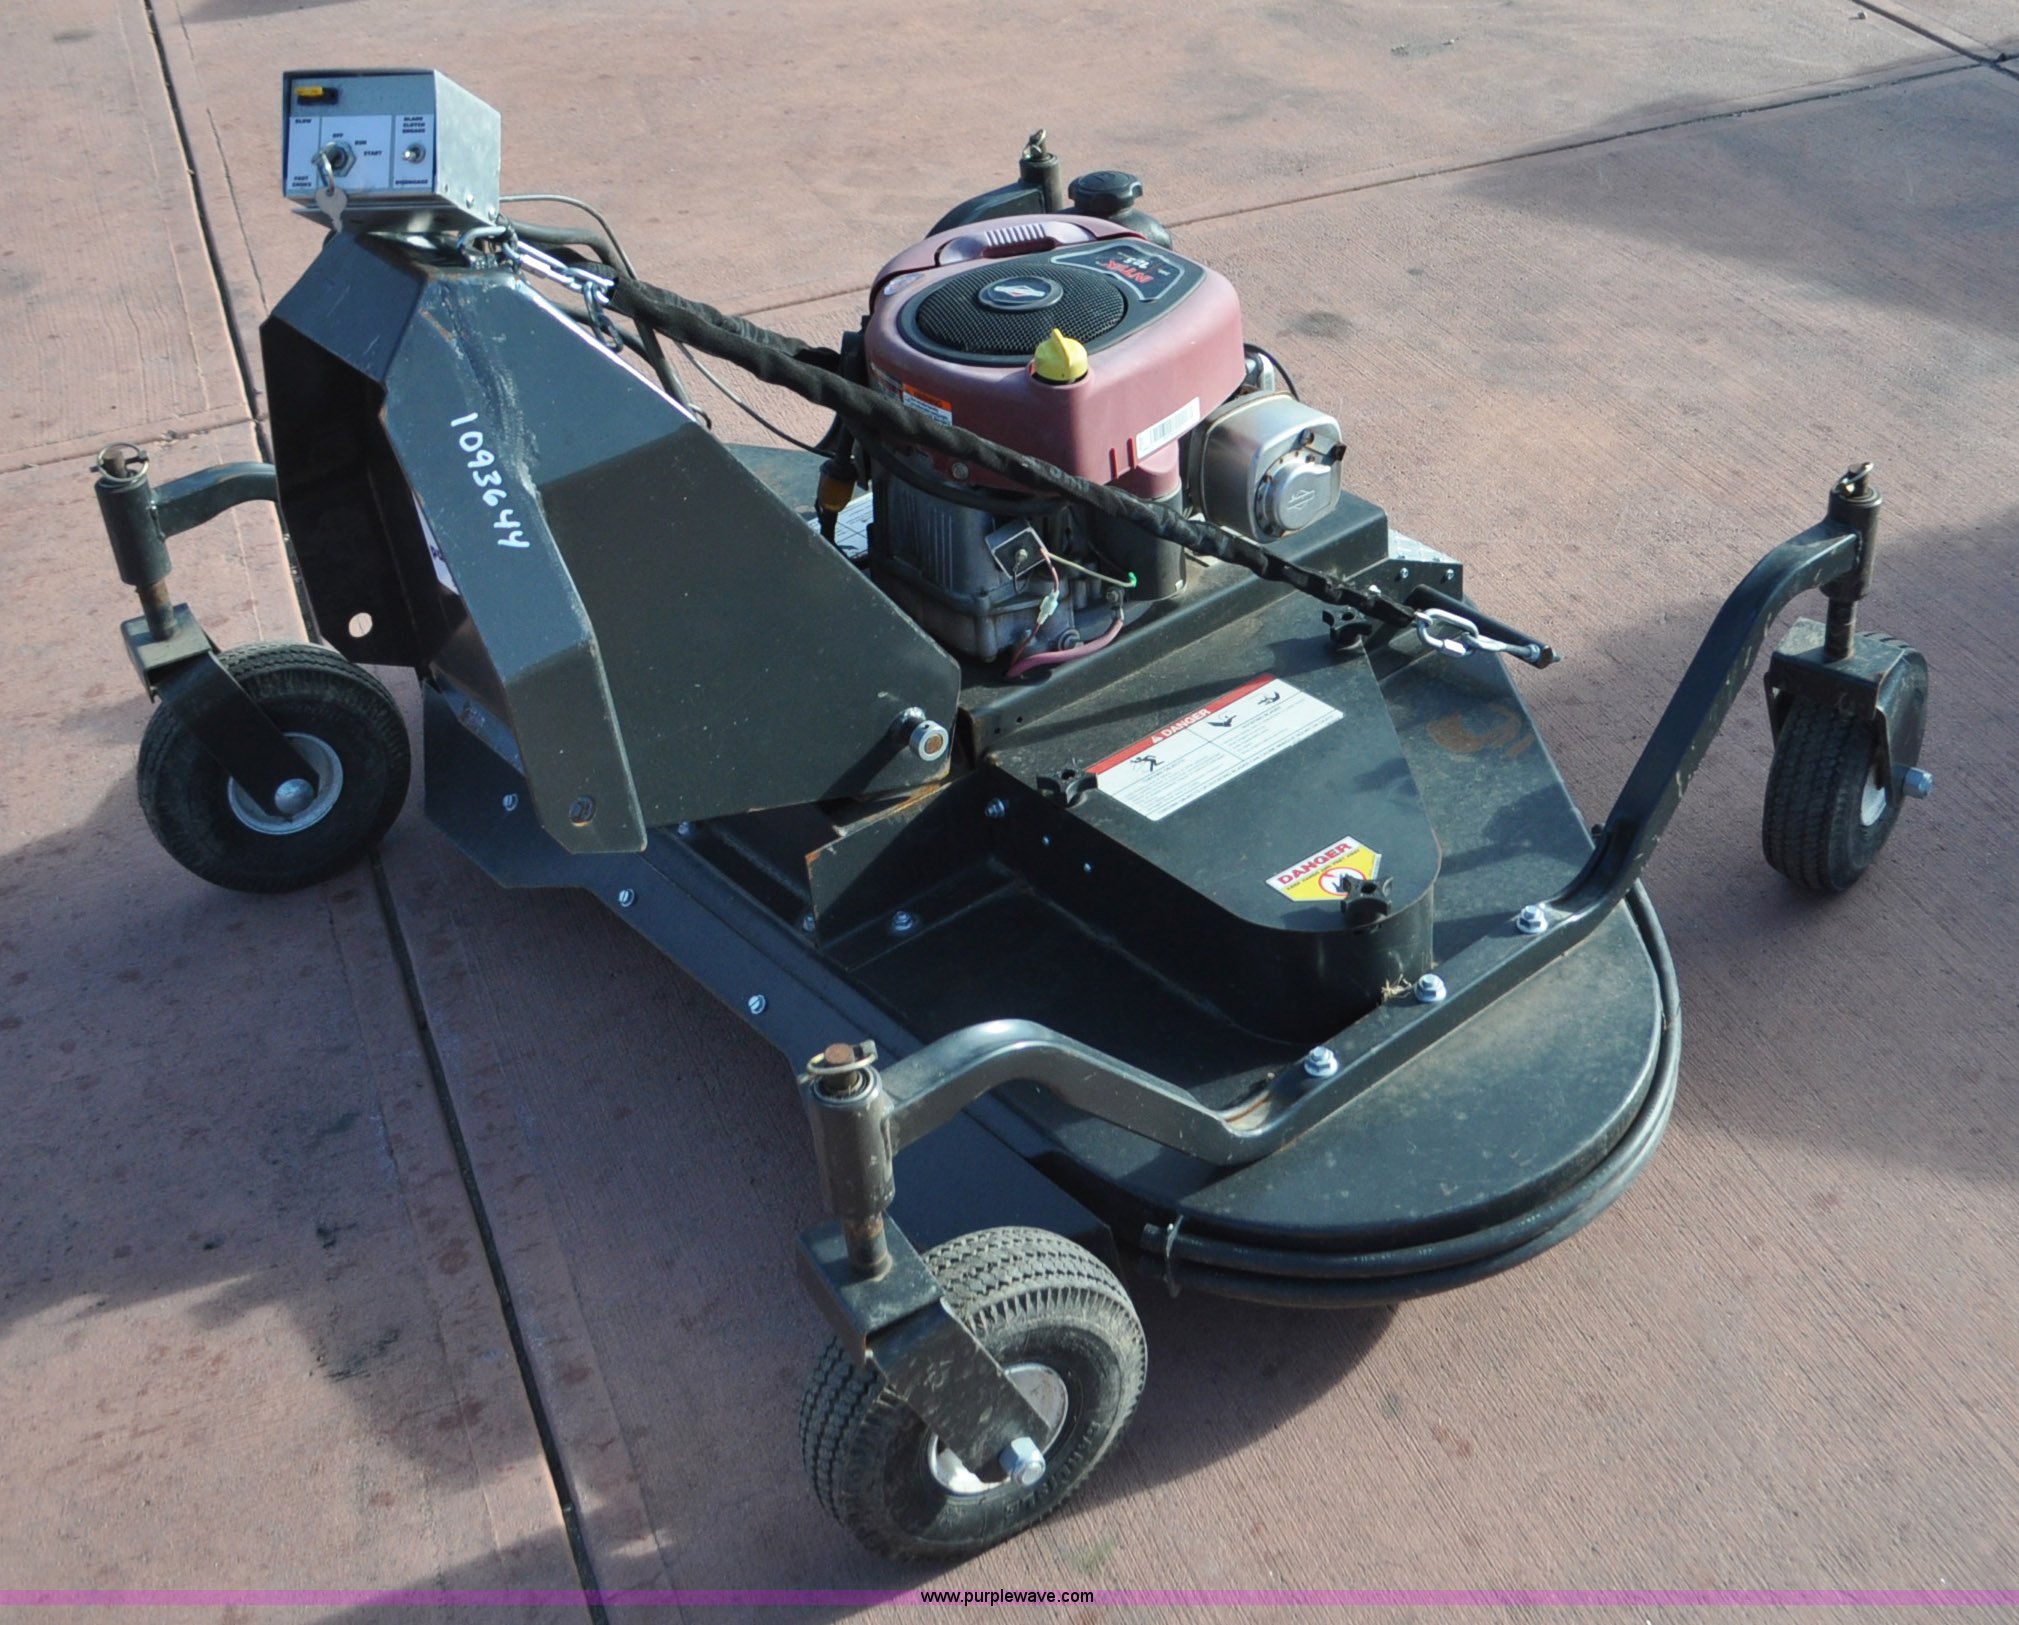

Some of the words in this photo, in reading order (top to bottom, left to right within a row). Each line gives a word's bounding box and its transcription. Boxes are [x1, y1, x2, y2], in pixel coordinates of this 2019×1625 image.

[450, 412, 530, 548] 1093644
[1161, 708, 1212, 739] DANGER
[1277, 843, 1352, 884] DANGER
